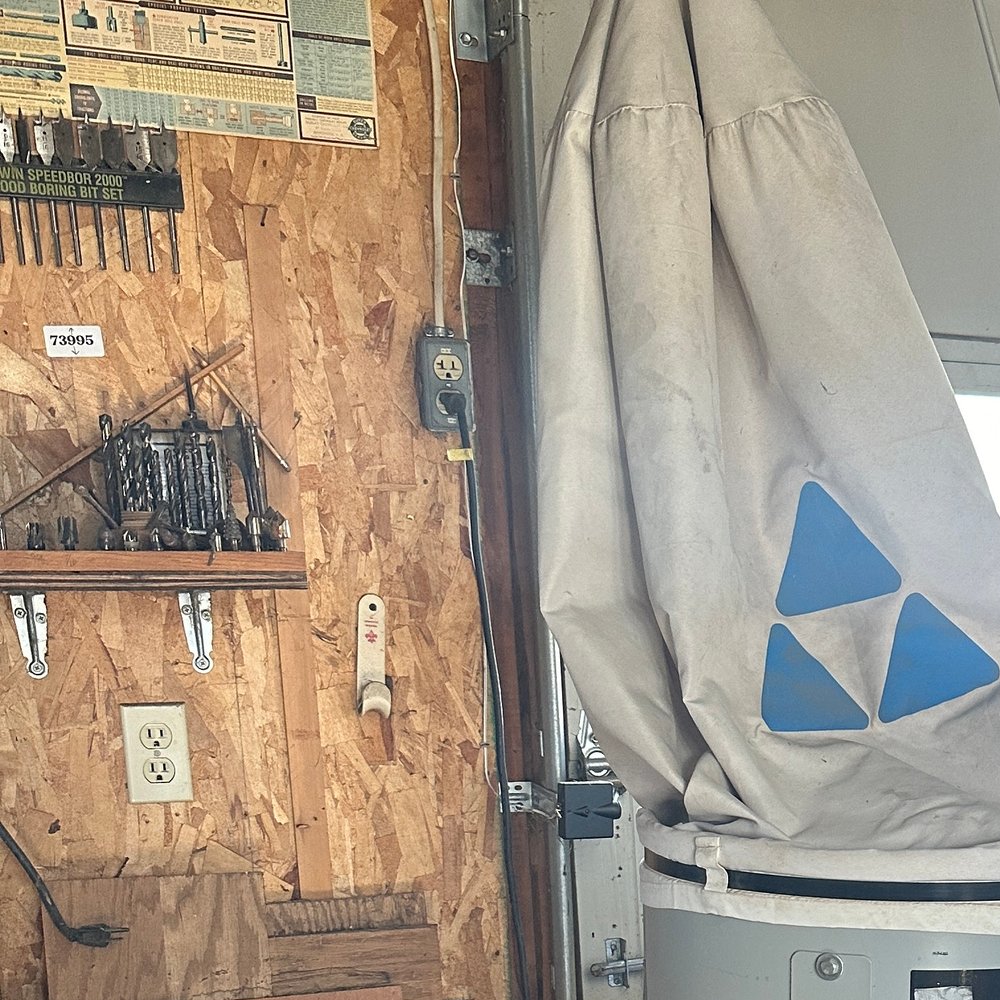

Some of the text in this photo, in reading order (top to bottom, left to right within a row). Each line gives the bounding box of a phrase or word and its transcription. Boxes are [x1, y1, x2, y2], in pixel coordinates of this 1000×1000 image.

[0, 167, 123, 187] WIN SPEEDBOR 2000
[0, 181, 124, 201] OOD BORING BIT SET
[49, 334, 94, 346] 73995
